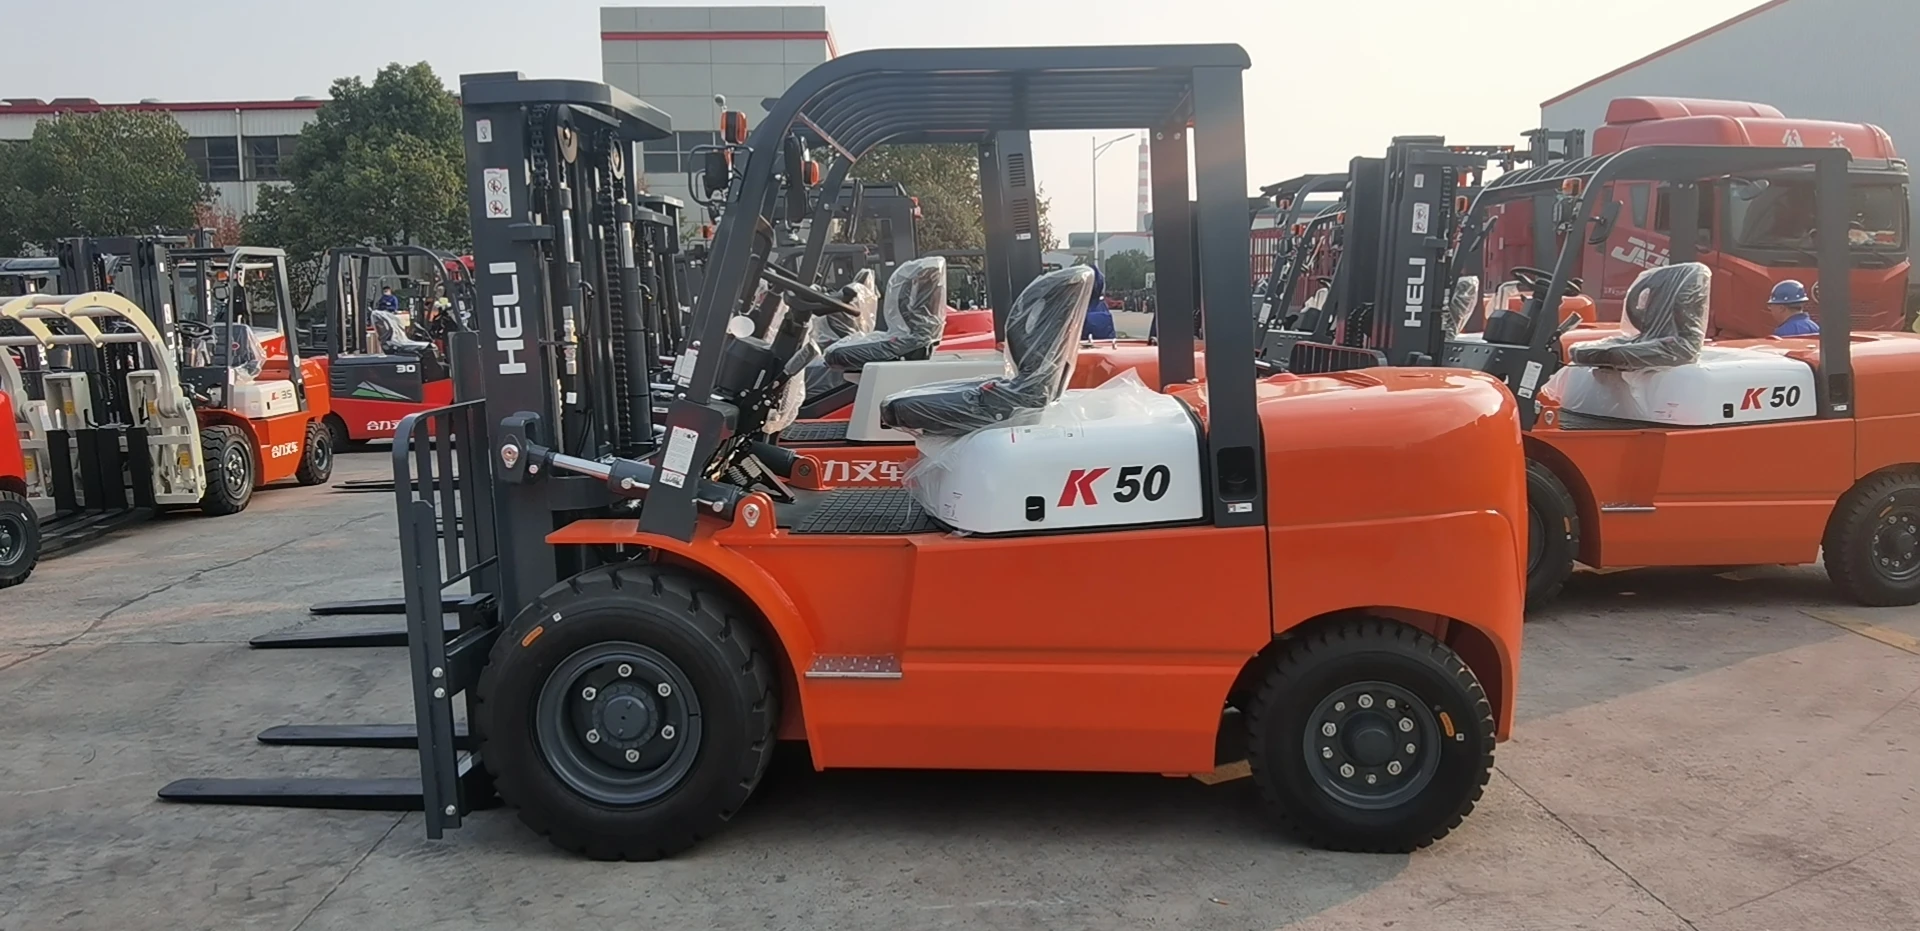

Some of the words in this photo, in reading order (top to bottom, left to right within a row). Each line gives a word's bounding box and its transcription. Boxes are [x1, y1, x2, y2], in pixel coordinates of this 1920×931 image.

[1404, 257, 1427, 327] HELI
[489, 262, 527, 374] HELI
[396, 364, 416, 373] 30
[1740, 387, 1768, 411] K
[1769, 385, 1801, 408] 50
[1056, 467, 1112, 508] K
[1112, 464, 1171, 503] 50
